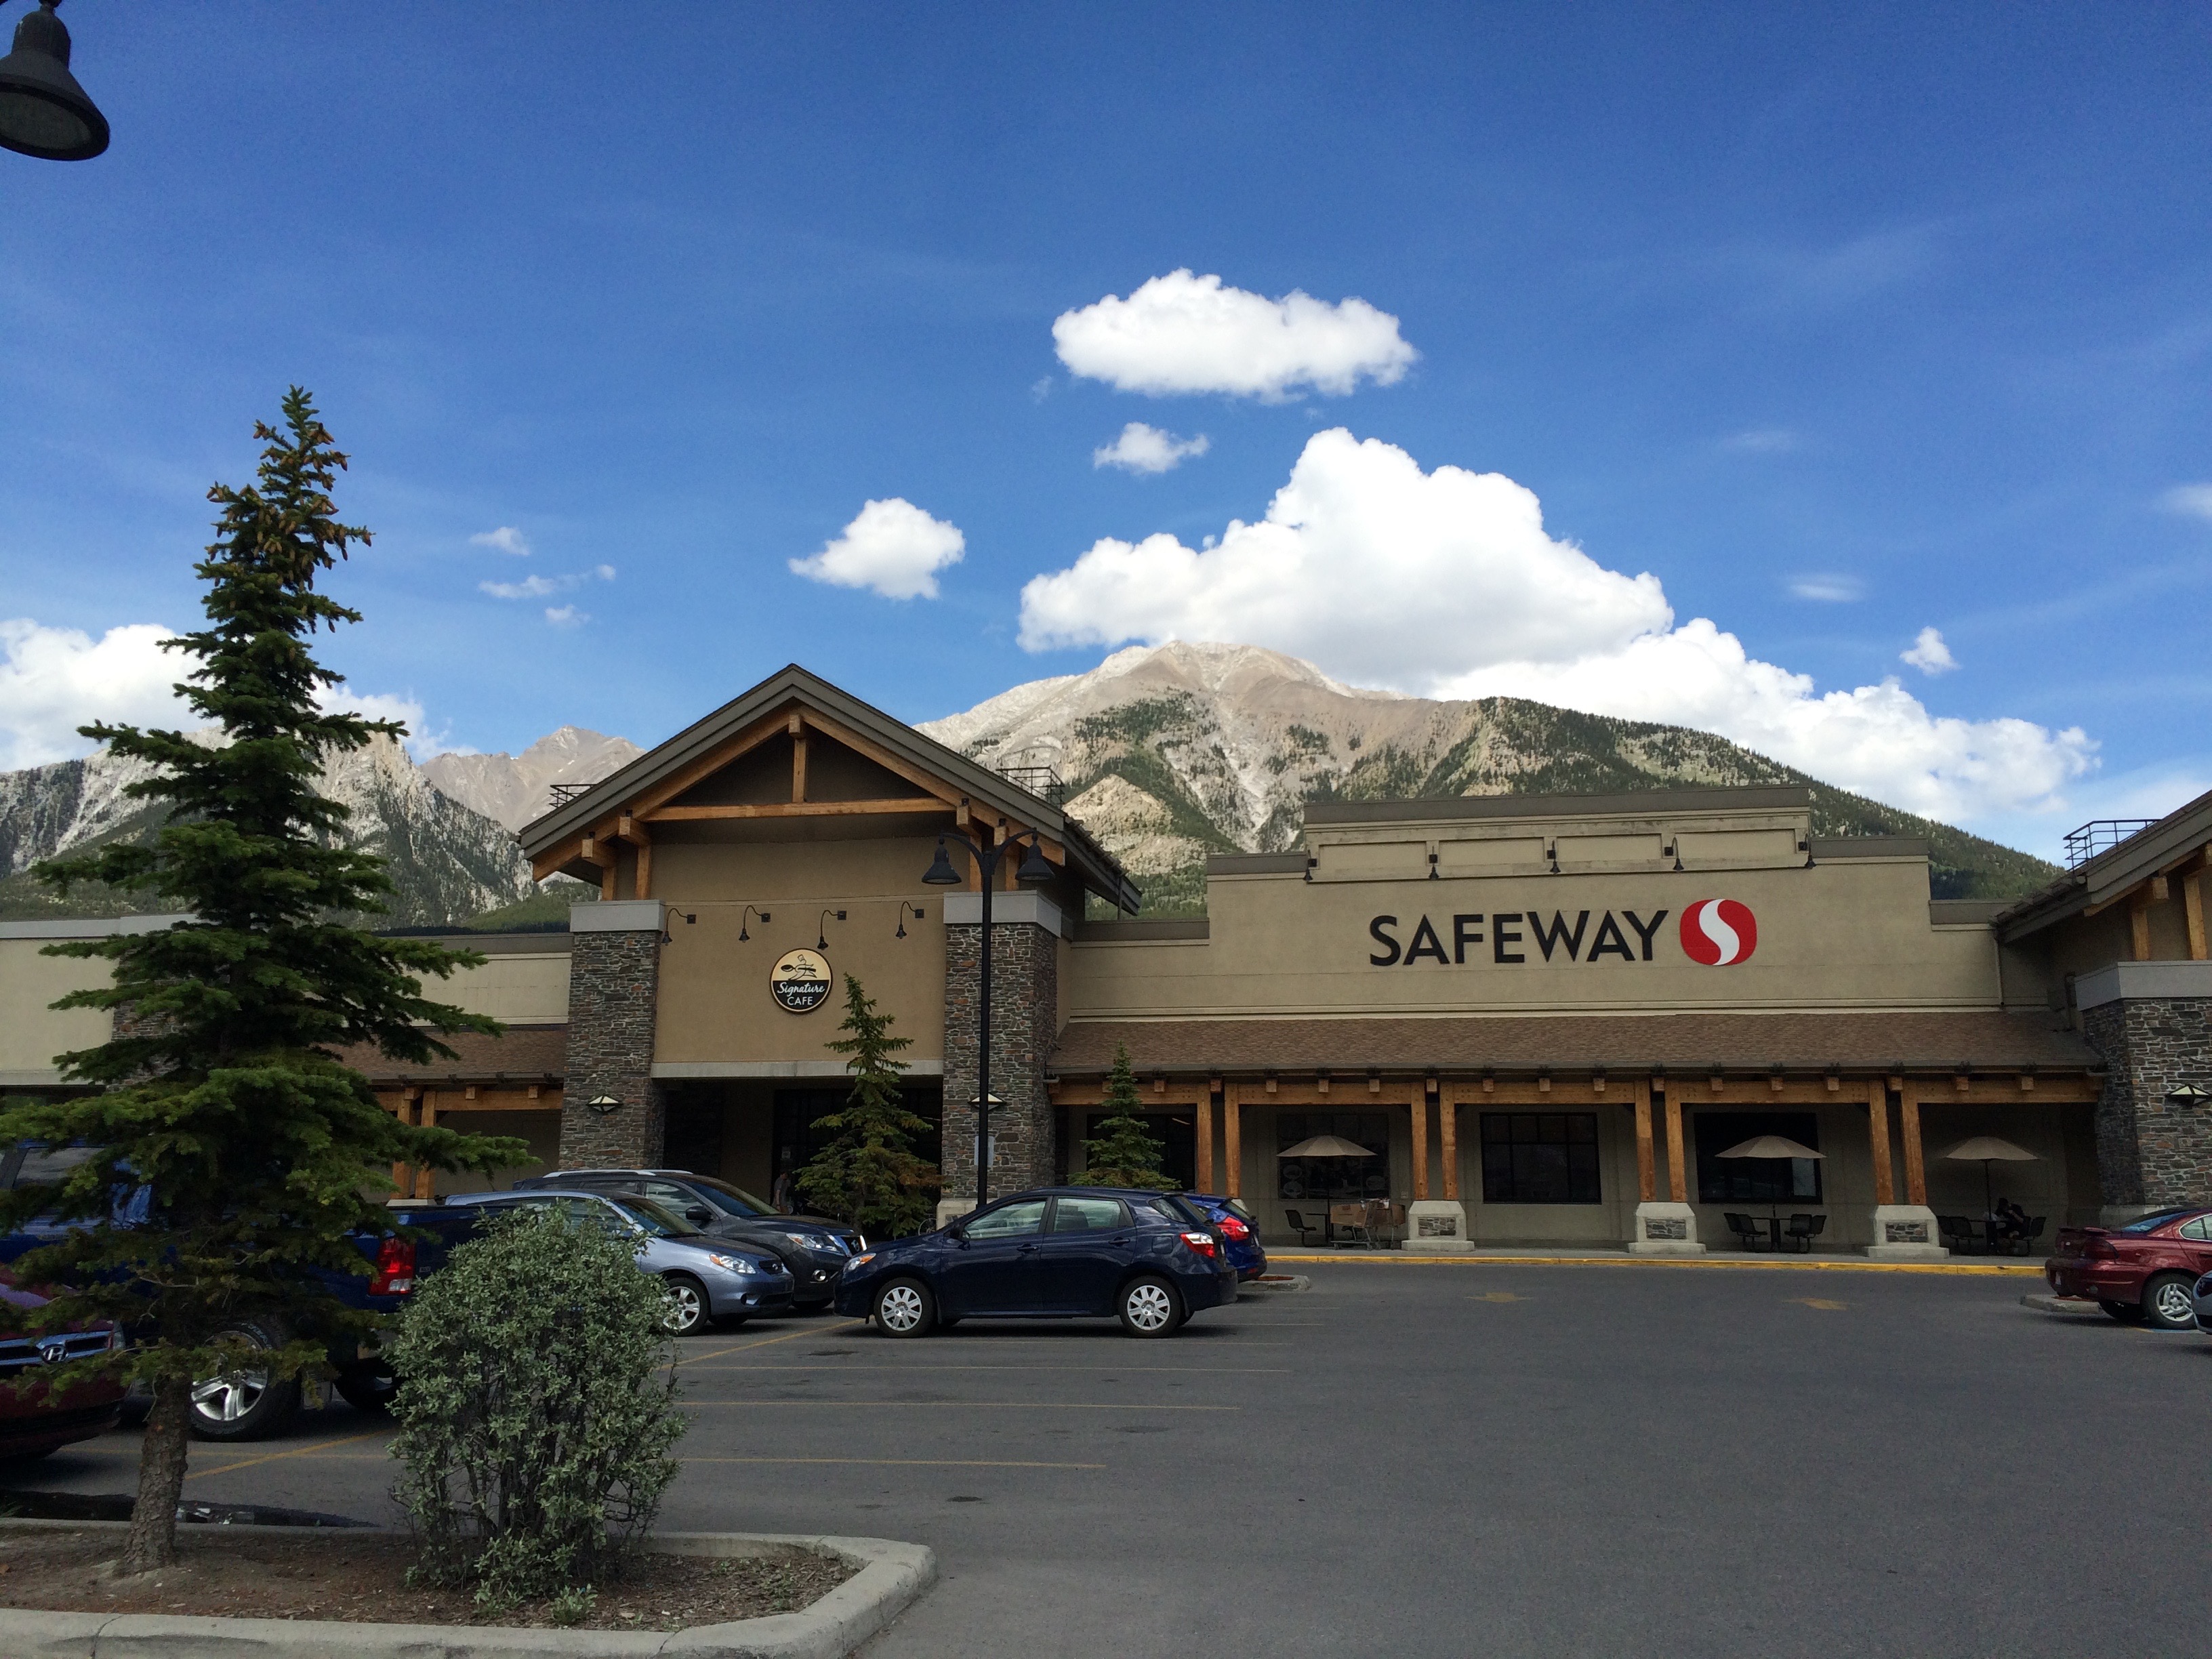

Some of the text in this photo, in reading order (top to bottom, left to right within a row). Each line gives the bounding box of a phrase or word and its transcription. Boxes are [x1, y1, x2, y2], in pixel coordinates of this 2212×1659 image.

[1369, 909, 1668, 966] SAFEWAY
[777, 981, 825, 997] Signature
[787, 996, 813, 1006] CAFE
